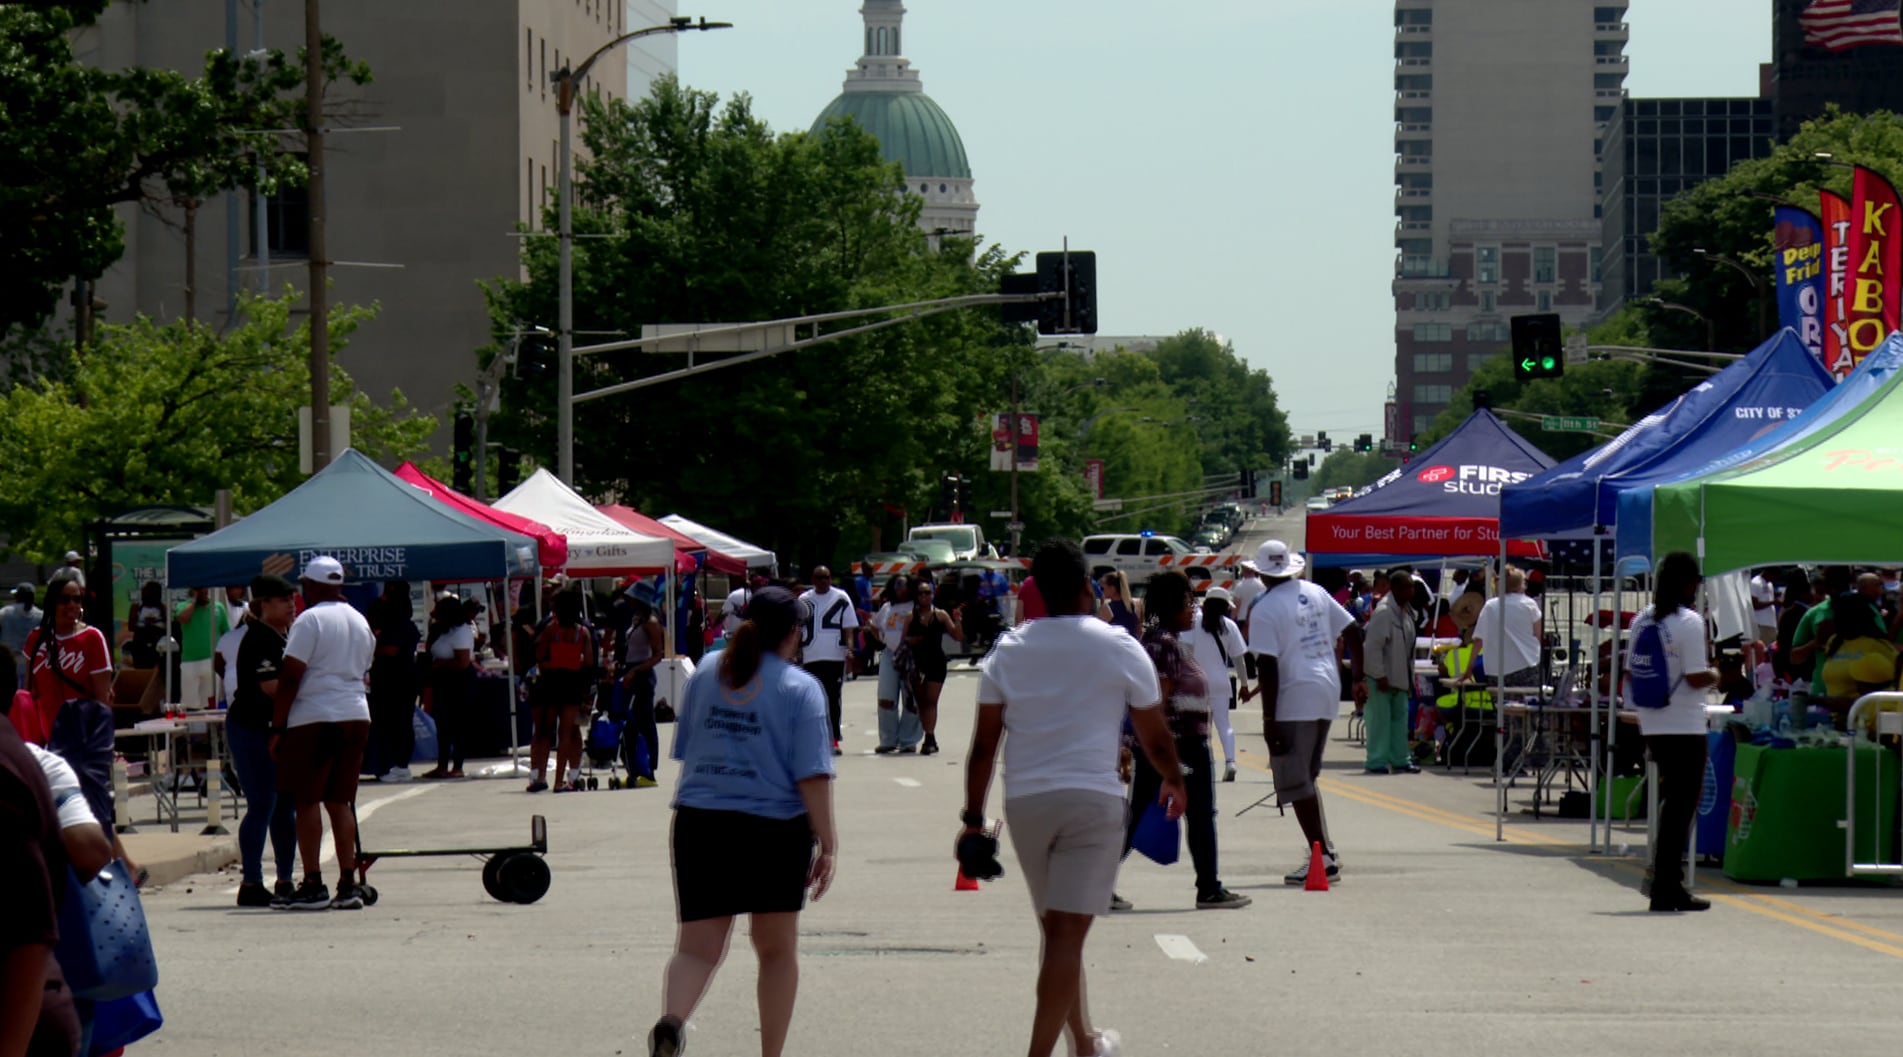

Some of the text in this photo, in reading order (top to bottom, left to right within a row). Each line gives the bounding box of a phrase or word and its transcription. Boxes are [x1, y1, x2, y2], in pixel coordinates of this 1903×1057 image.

[1735, 406, 1763, 419] CITY
[1767, 406, 1784, 419] OF
[1331, 525, 1360, 539] Your
[1365, 526, 1395, 540] Best
[1399, 526, 1450, 540] Partner
[1454, 526, 1473, 541] for
[596, 545, 628, 557] Gifts
[133, 567, 153, 578] THE
[355, 563, 406, 578] TRUST
